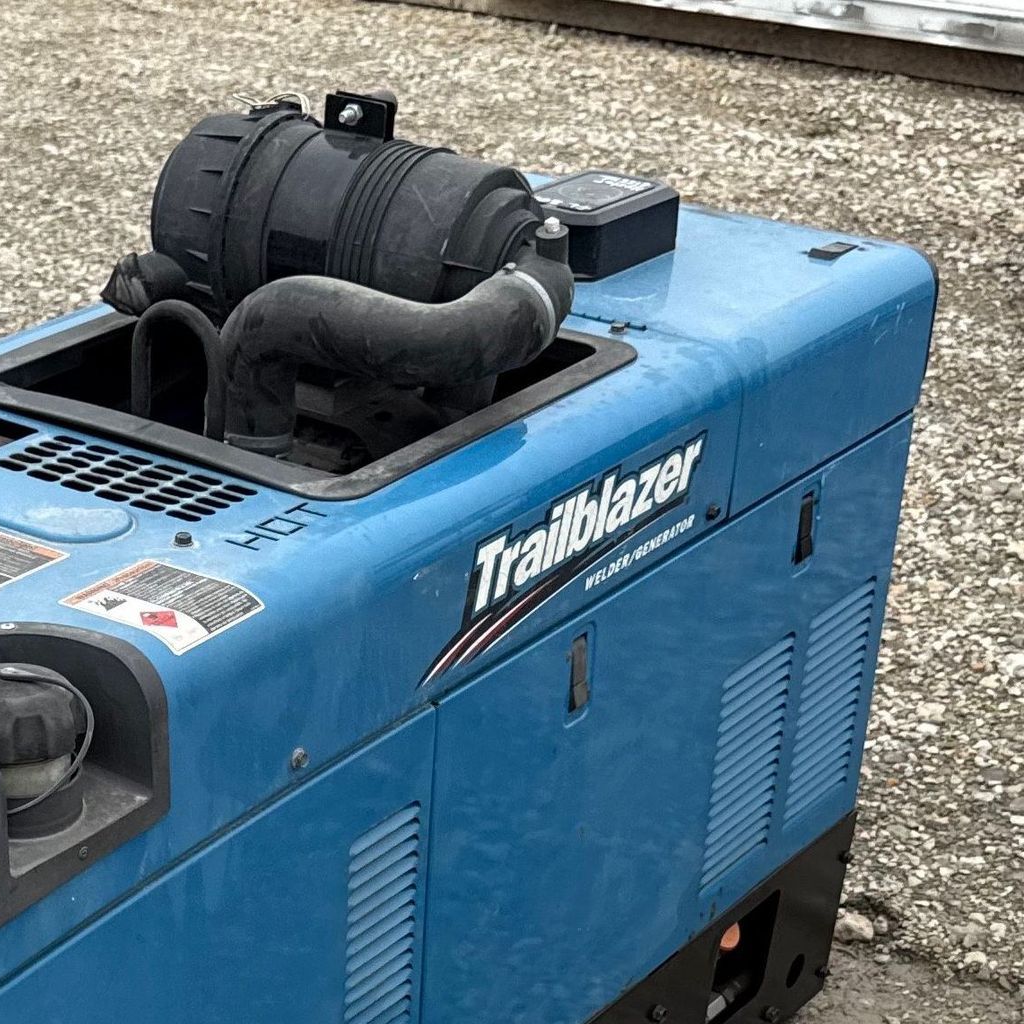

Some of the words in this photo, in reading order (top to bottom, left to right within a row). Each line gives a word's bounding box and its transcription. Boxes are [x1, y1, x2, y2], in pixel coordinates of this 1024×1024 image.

[225, 502, 329, 551] HOT
[474, 439, 704, 613] Trailblazer
[584, 513, 696, 592] WELDER/GENERATOR
